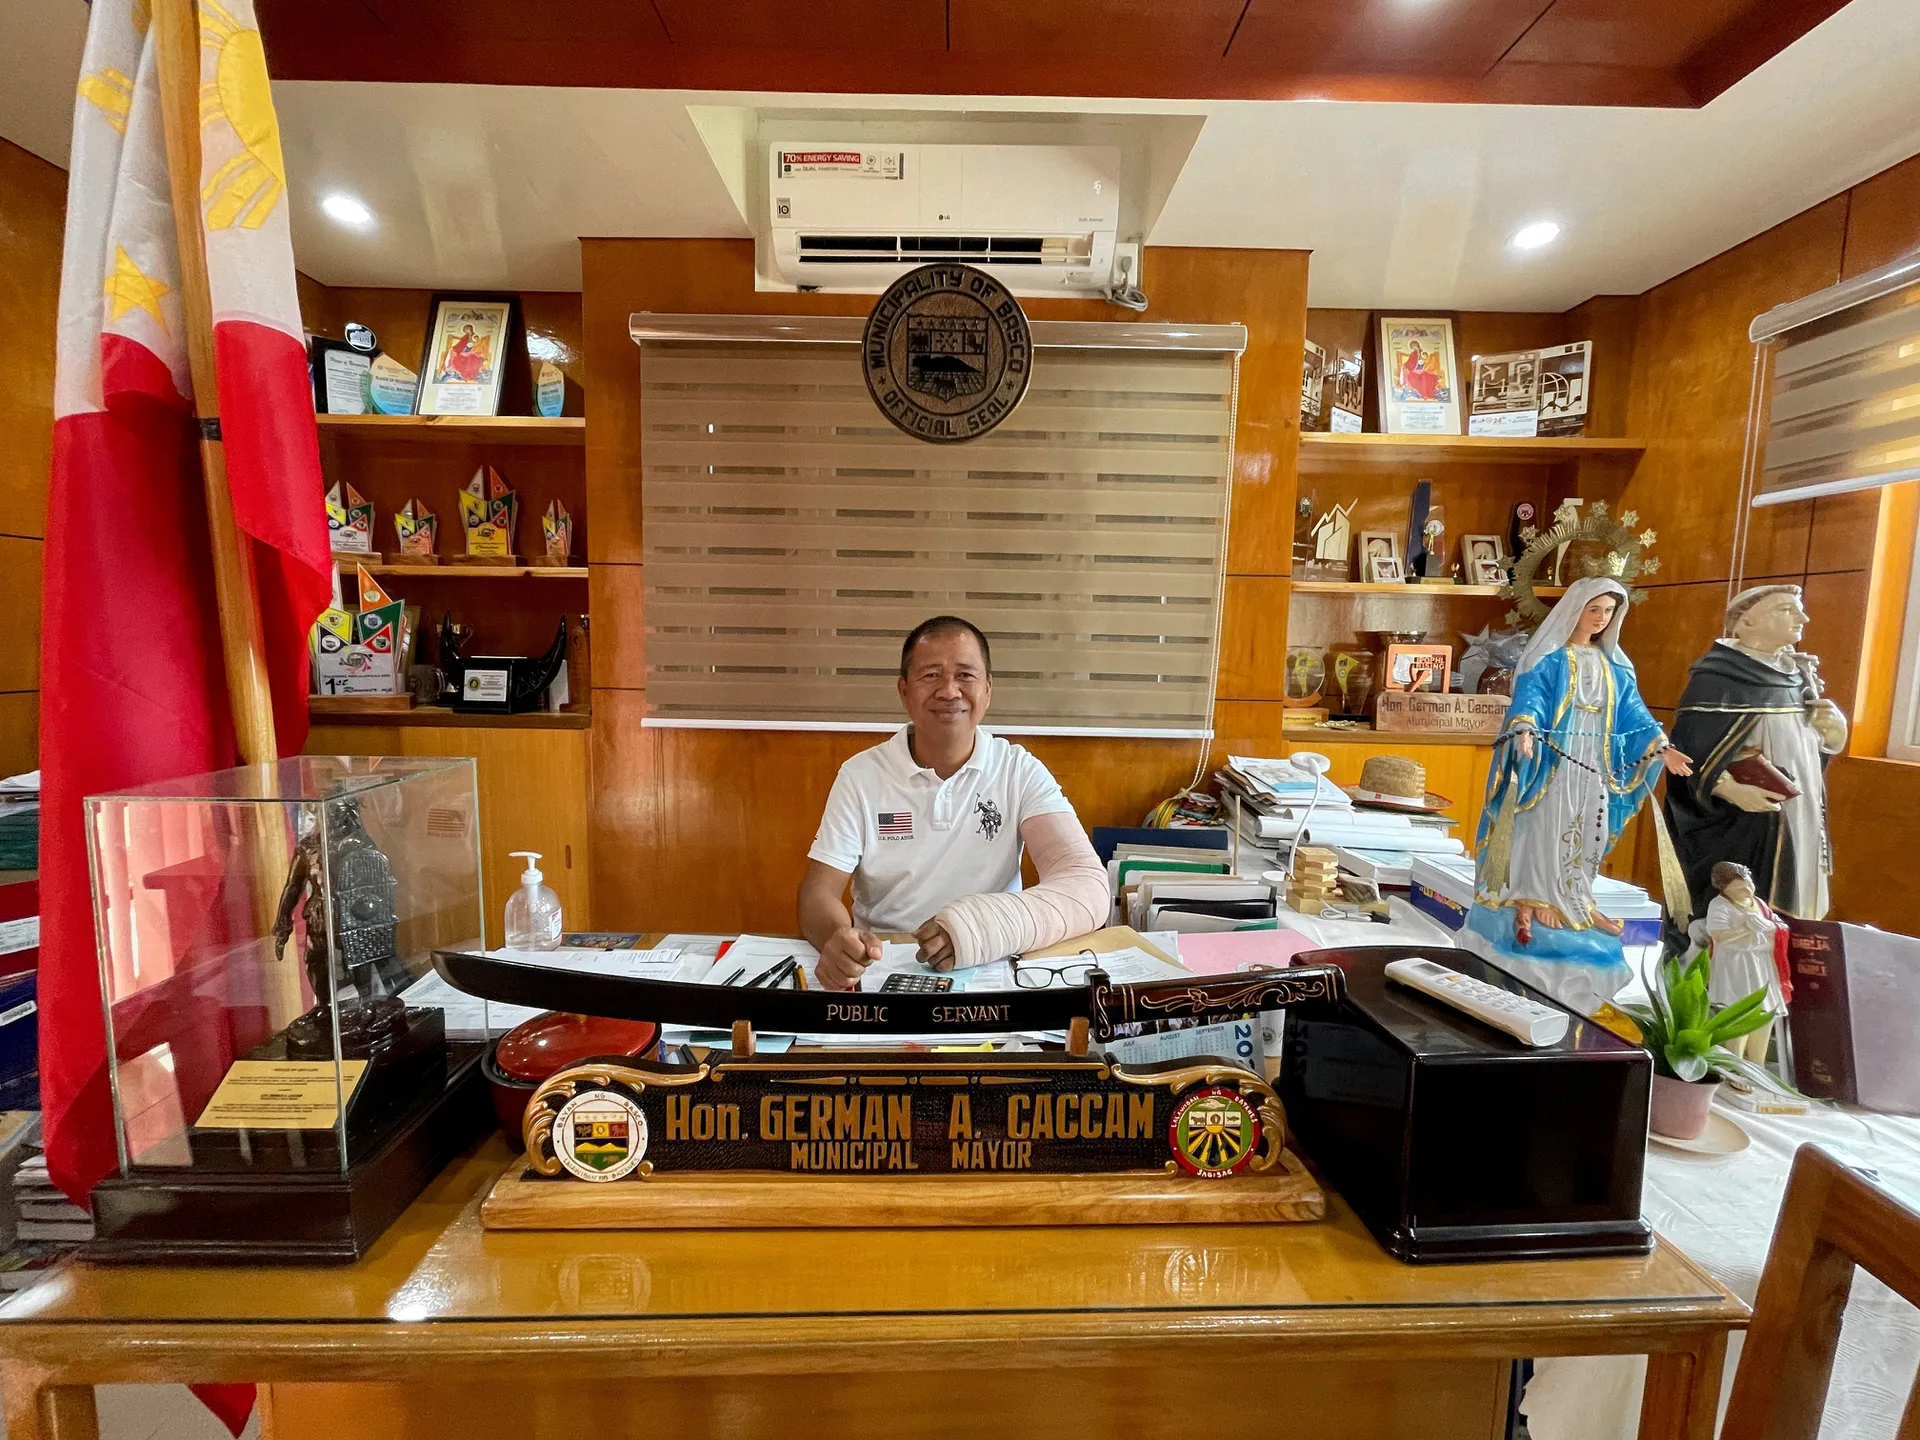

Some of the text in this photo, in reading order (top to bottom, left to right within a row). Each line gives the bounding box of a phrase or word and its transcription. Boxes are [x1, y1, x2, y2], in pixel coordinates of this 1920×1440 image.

[785, 154, 859, 163] 70% ENERGY SAVING
[870, 270, 1026, 374] MUNICIPALITY OF BASCO
[883, 390, 1011, 436] OFFICIAL SEAL
[1382, 697, 1403, 711] Hon.
[1408, 697, 1451, 713] German
[1454, 698, 1465, 713] A.
[1406, 716, 1485, 730] Municipal Mayor
[826, 1004, 1010, 1022] PUBLIC SERVANT
[1160, 1033, 1181, 1041] AUGUST
[1195, 1025, 1225, 1035] SEPTEMBER
[557, 1102, 577, 1128] BAYAN
[623, 1101, 644, 1127] BASCO
[665, 1093, 1154, 1141] Hon. GERMAN A. CACCAM
[791, 1140, 1032, 1170] MUNICIPAL MAYOR
